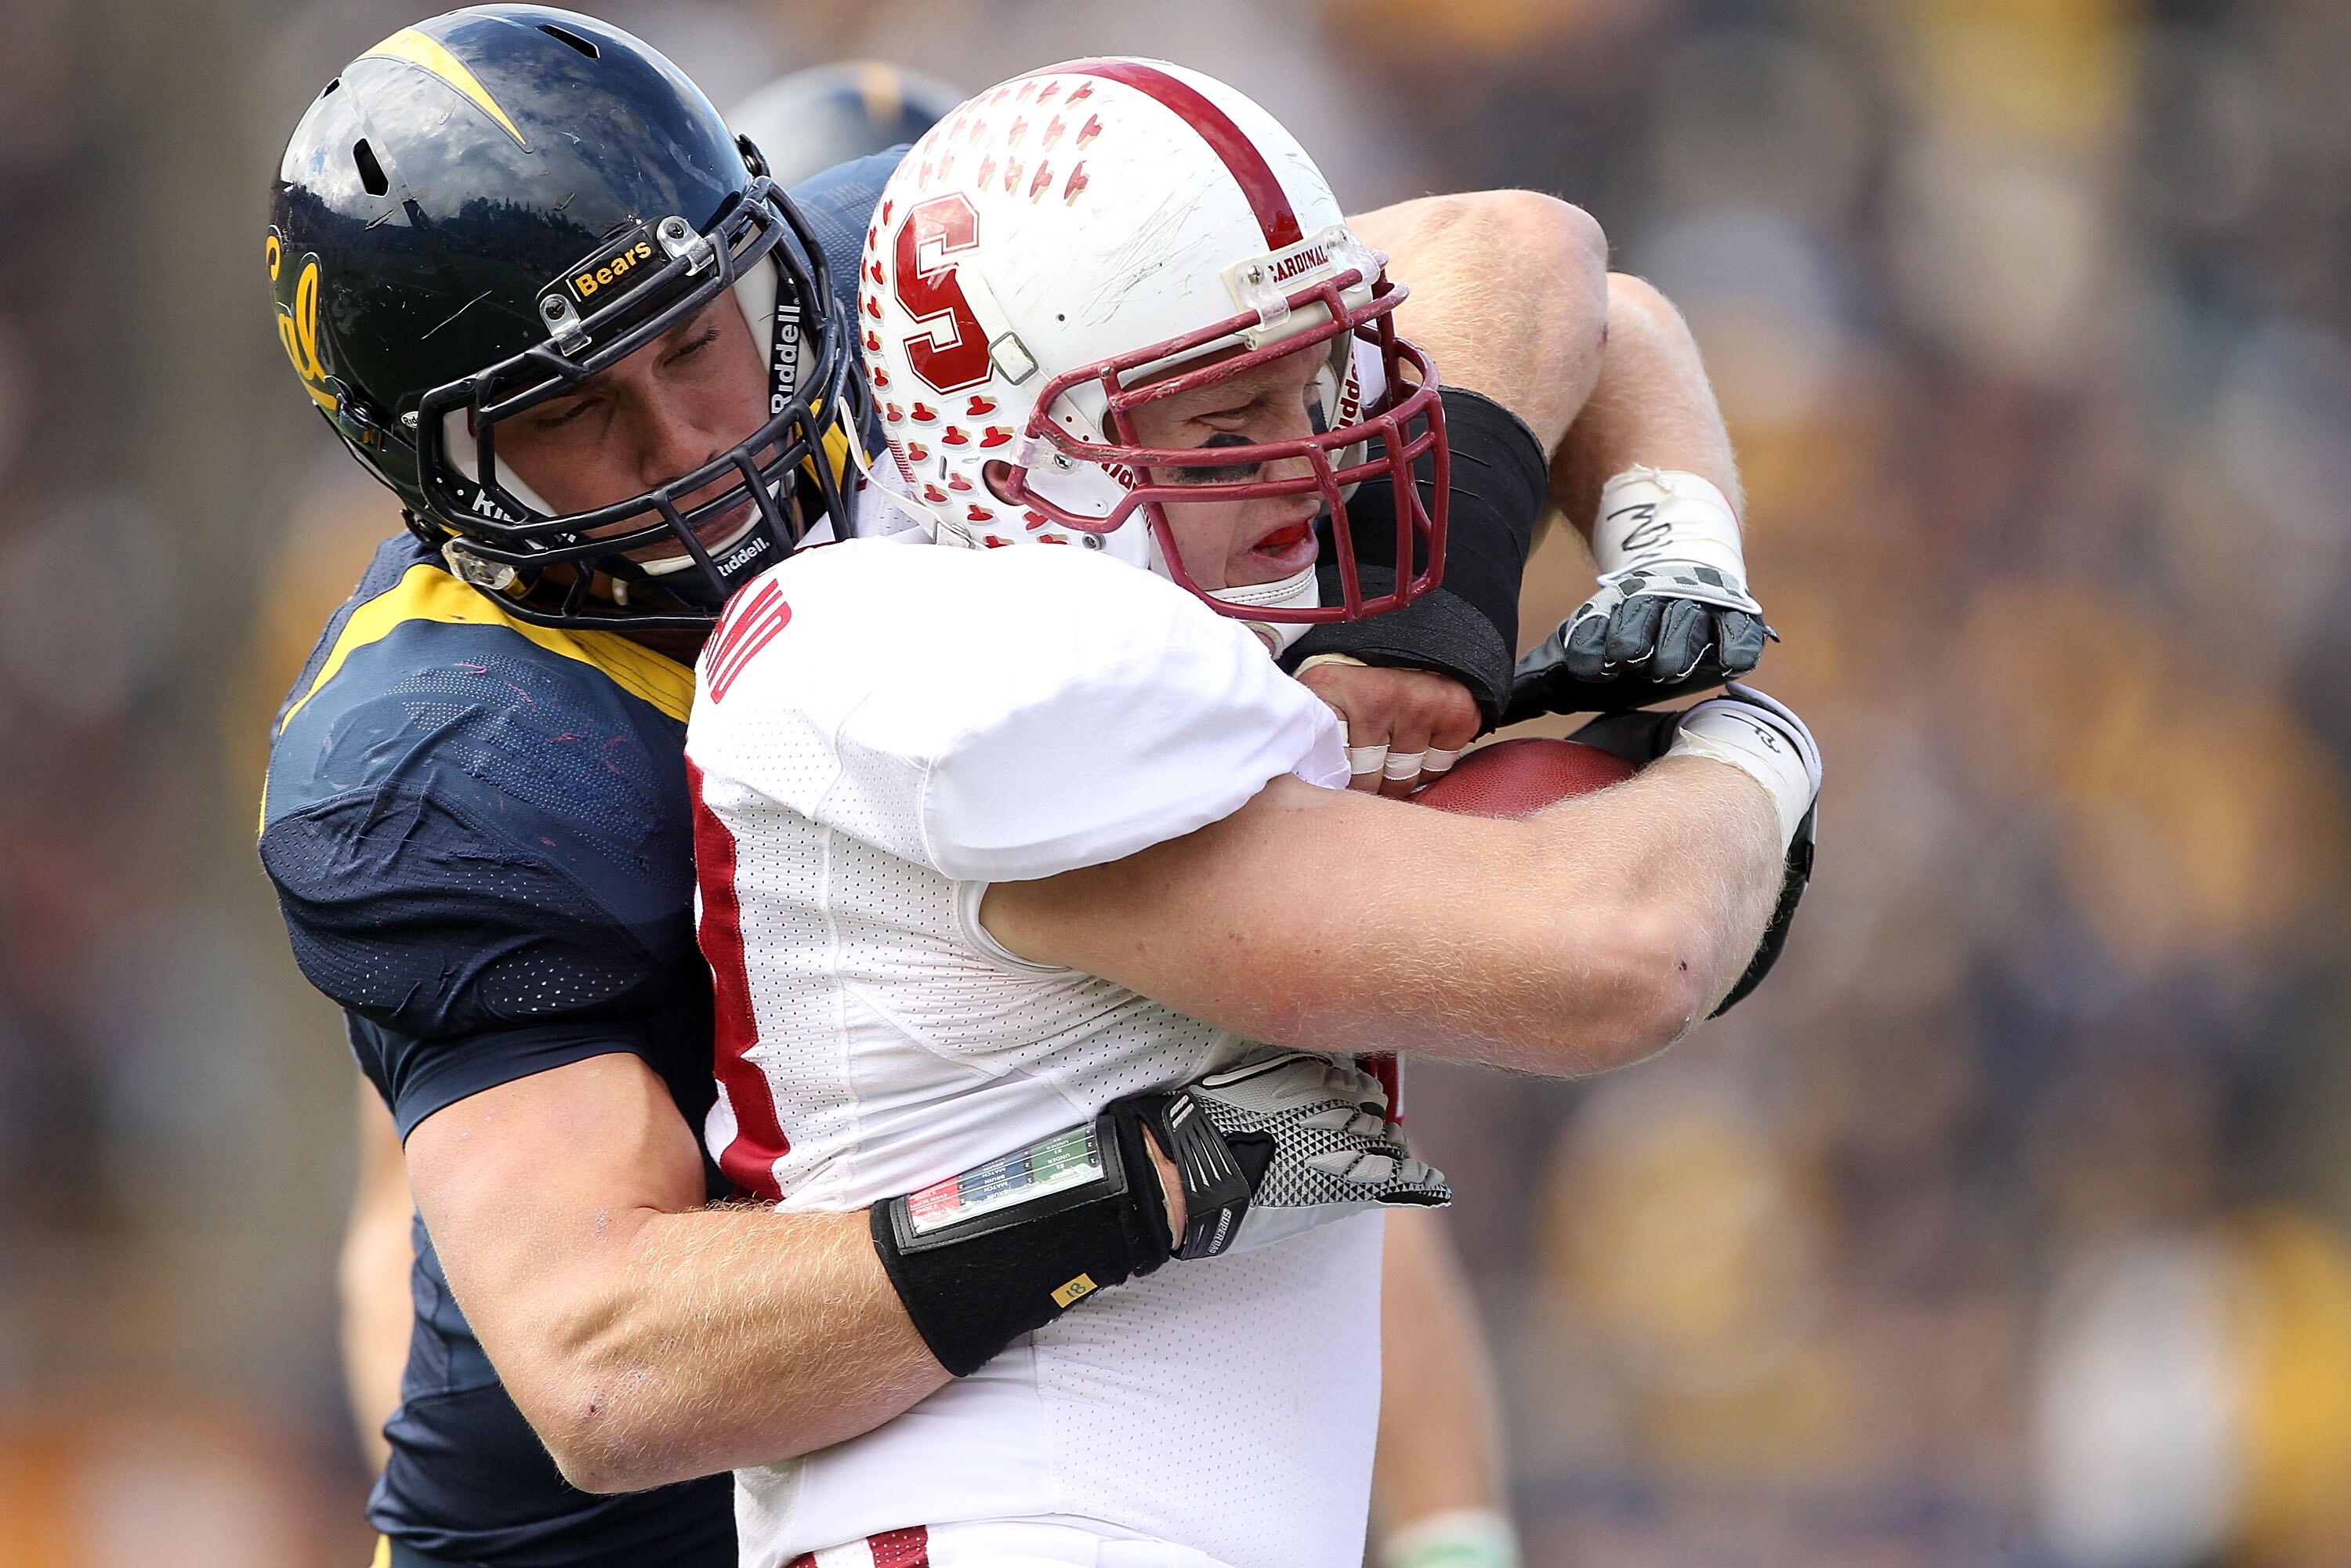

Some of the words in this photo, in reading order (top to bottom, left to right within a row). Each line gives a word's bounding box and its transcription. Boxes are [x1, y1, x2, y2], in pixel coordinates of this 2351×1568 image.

[574, 241, 652, 297] Bears
[893, 191, 995, 396] S
[770, 304, 801, 414] Riddell
[1048, 1153, 1071, 1164] UNDER
[984, 1174, 1005, 1184] BRUIN
[984, 1181, 1009, 1193] MATCH
[930, 1193, 947, 1202] EVEN
[1208, 1208, 1233, 1254] SUPERBAD
[1066, 1282, 1086, 1298] 18
